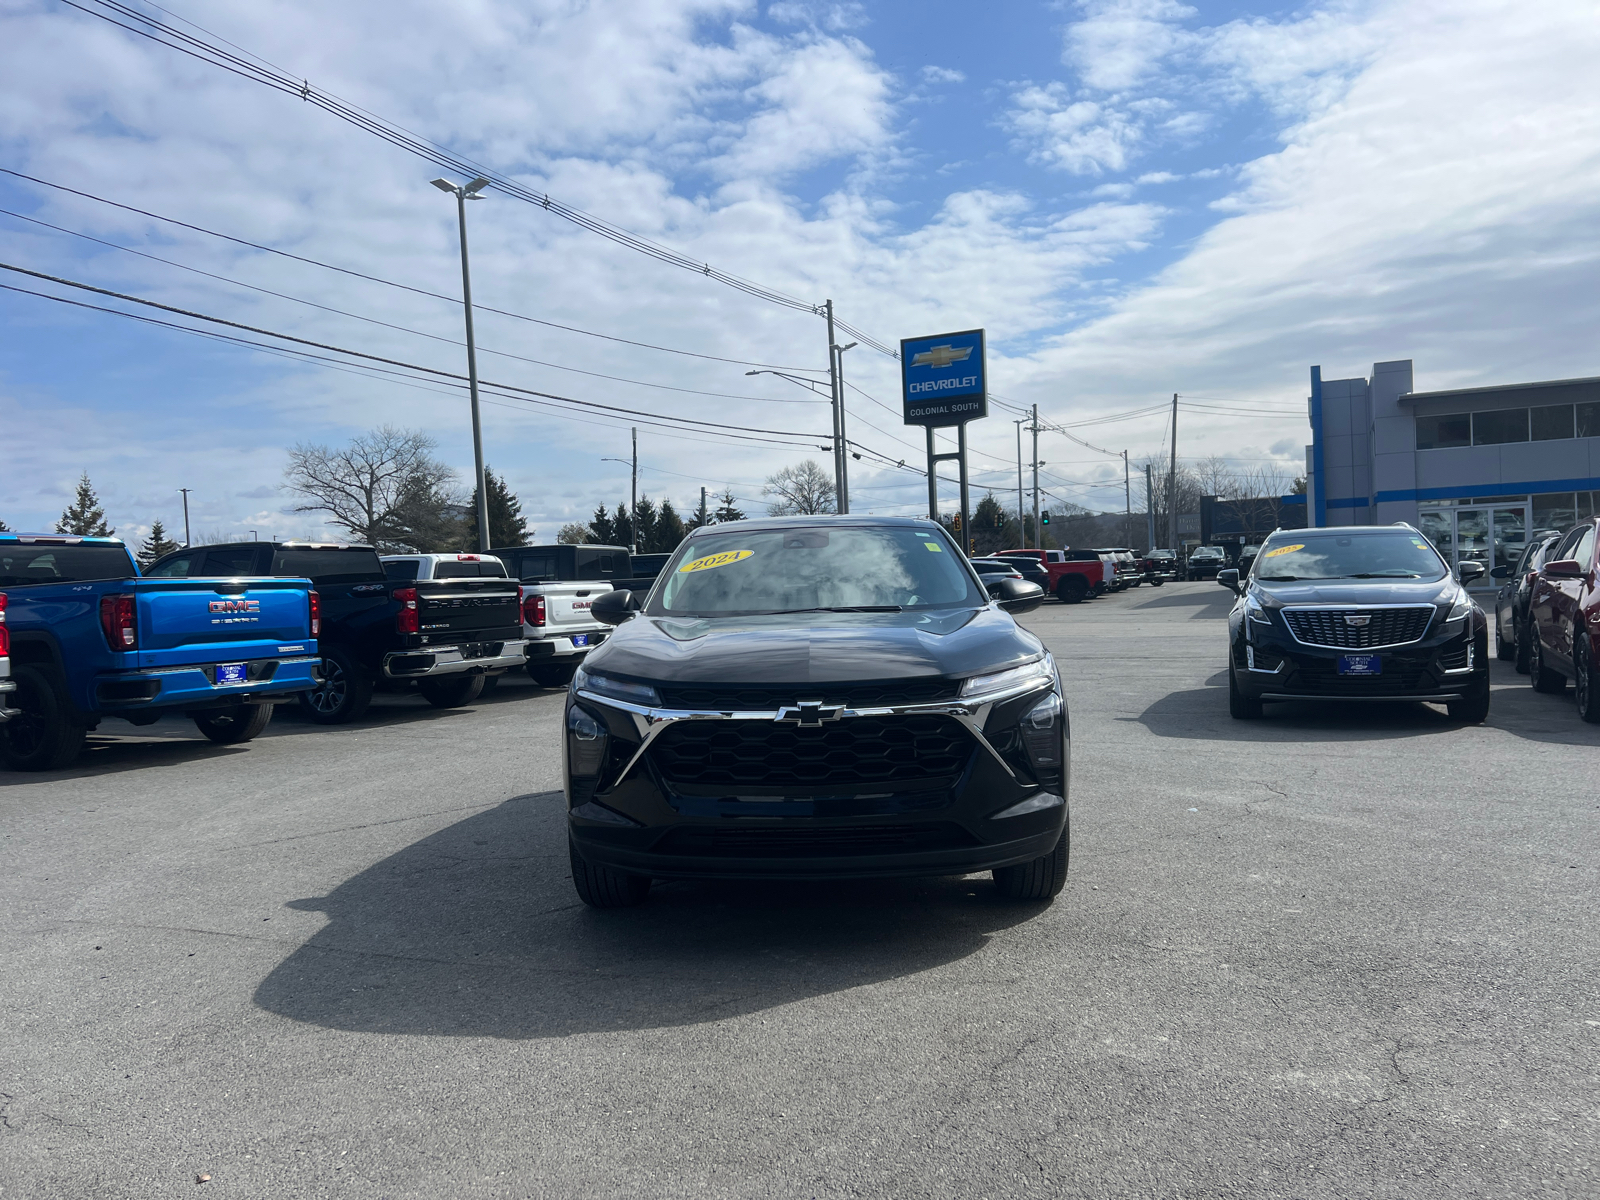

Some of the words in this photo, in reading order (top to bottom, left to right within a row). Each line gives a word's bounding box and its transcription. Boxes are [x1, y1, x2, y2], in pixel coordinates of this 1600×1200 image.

[909, 375, 977, 393] CHEVROLET
[910, 405, 949, 416] COLONIAL
[951, 402, 979, 412] SOUTH
[691, 551, 741, 570] 2024
[209, 600, 260, 613] GMC
[428, 597, 515, 609] CHEVROLET
